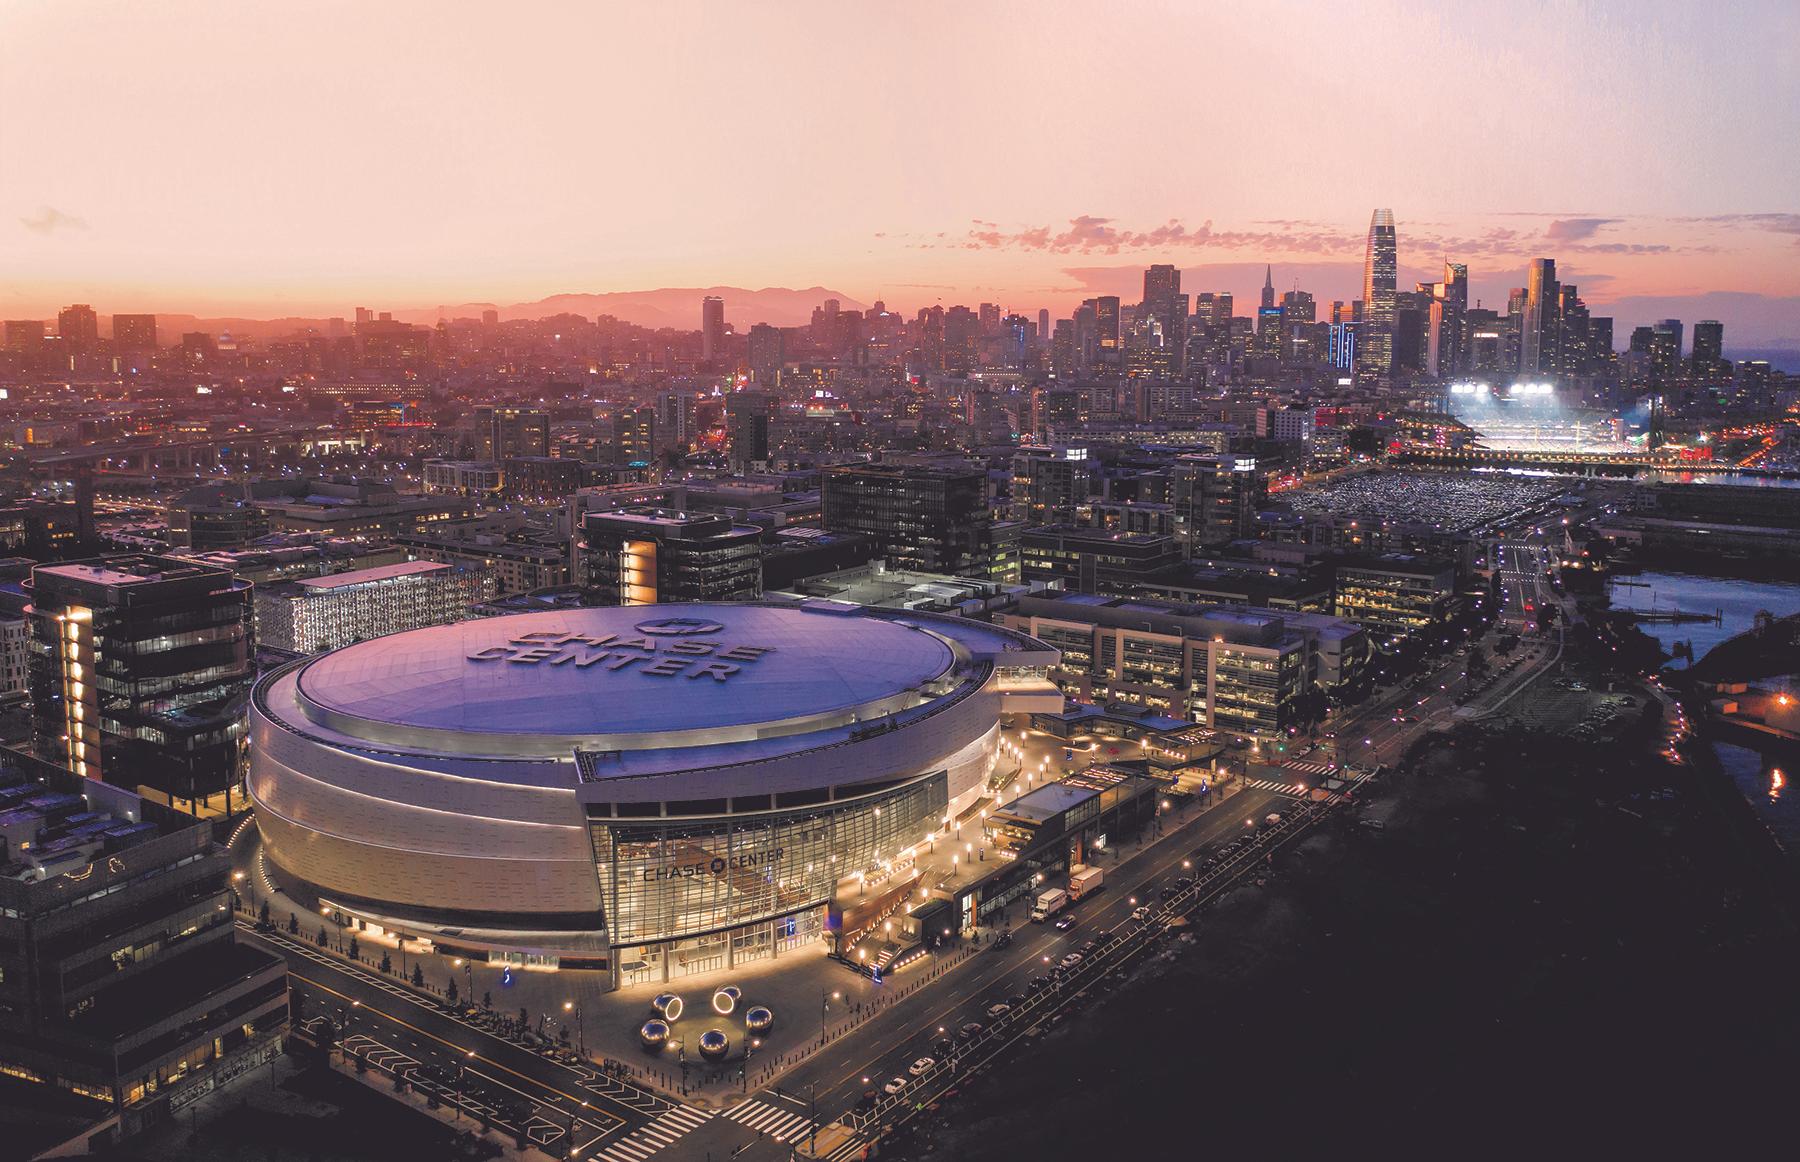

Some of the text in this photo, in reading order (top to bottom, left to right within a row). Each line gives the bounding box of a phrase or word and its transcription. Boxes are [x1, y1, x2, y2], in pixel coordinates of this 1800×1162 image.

[508, 632, 777, 661] CHASE
[466, 648, 742, 681] CENTER
[643, 847, 785, 882] CHASE CENTER
